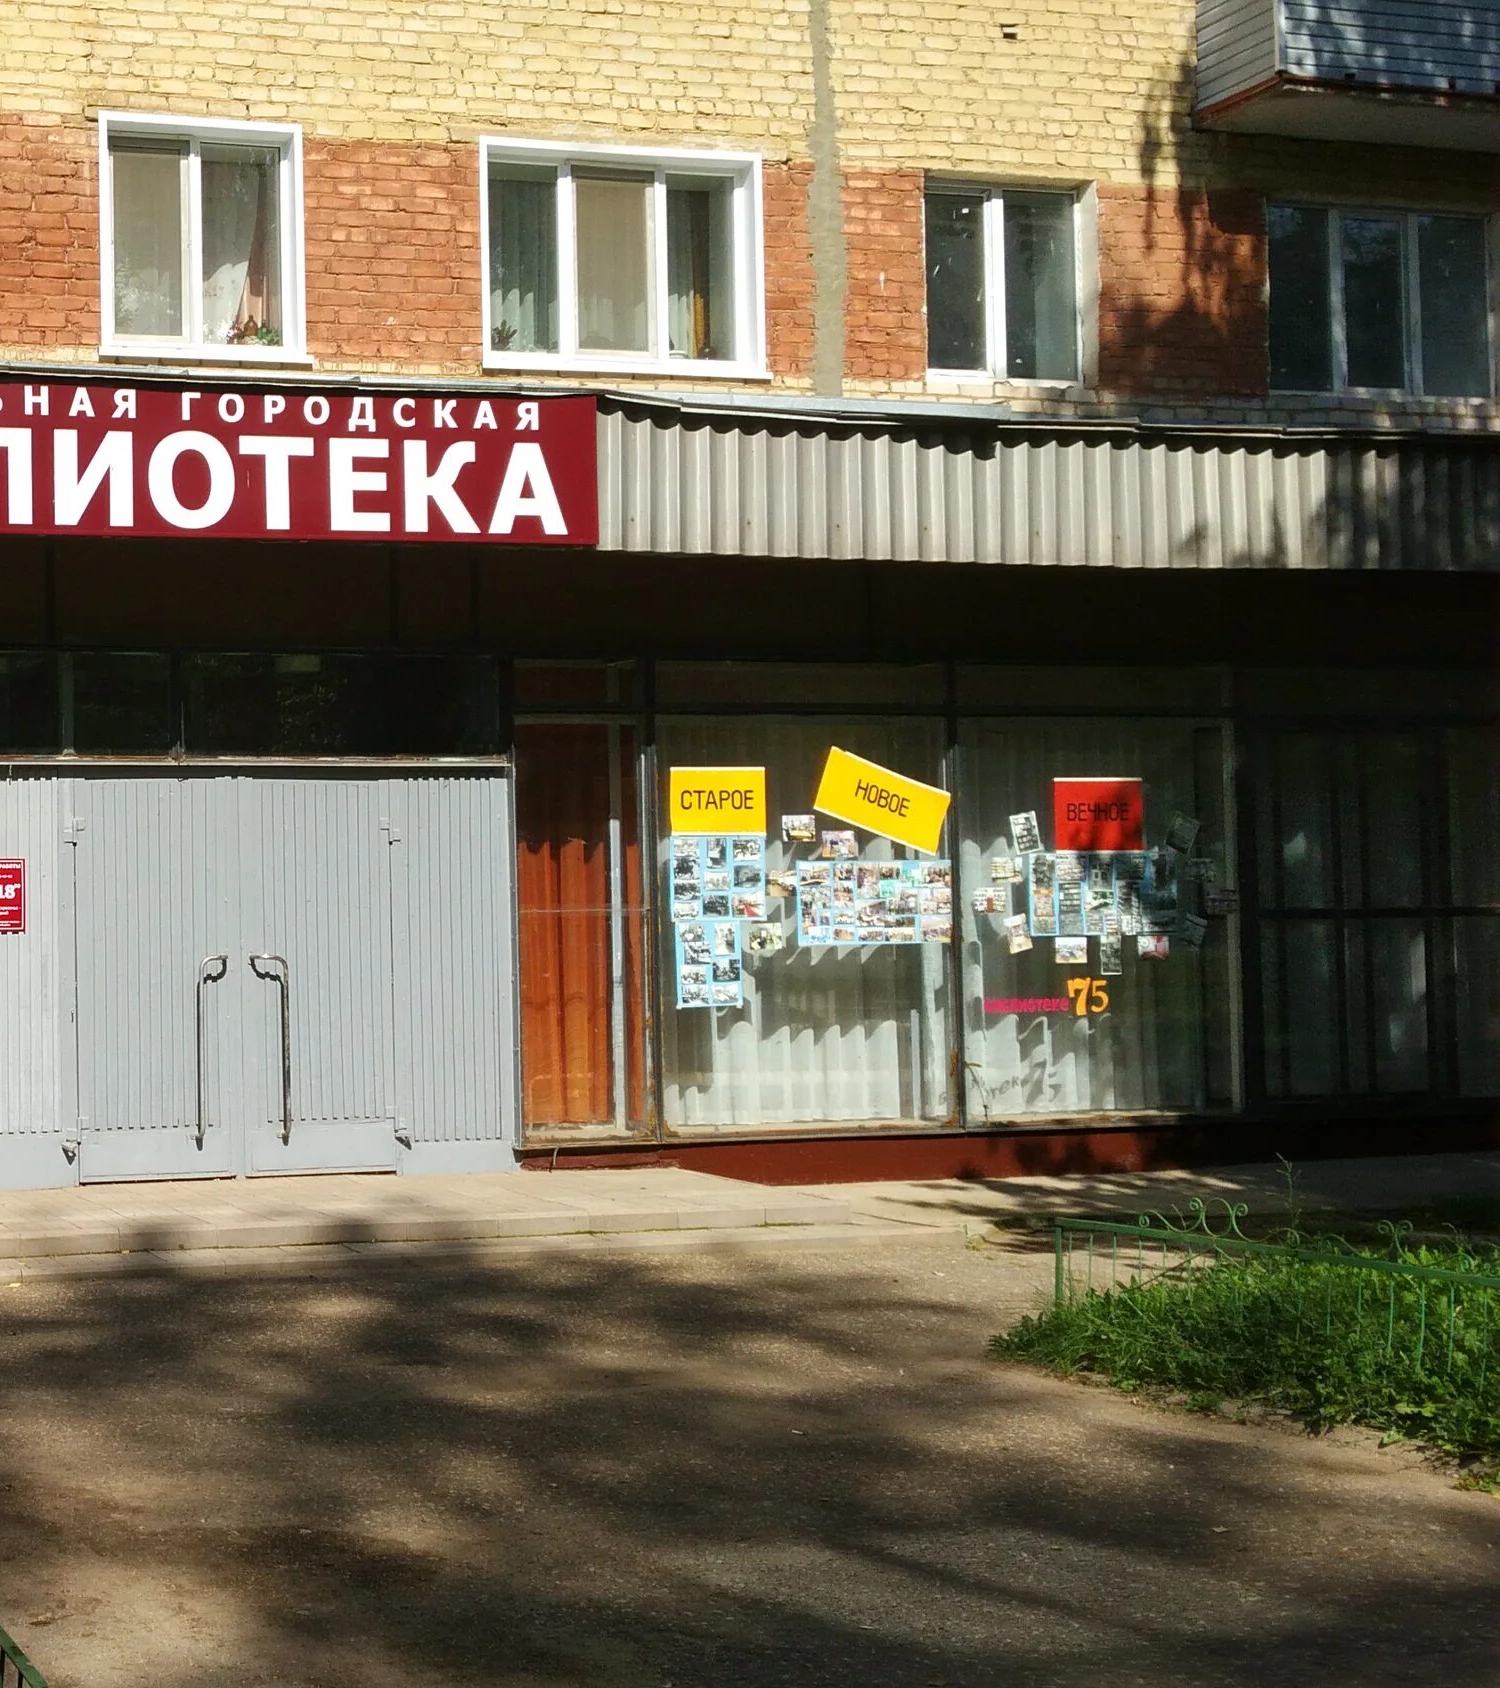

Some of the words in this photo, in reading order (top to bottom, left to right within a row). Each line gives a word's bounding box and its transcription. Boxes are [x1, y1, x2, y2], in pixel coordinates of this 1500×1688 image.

[181, 391, 540, 432] ГОРОДСКАЯ
[680, 789, 755, 811] СТАРОЕ
[854, 778, 911, 818] НОВОЕ
[1066, 802, 1129, 822] ВЕЧНОЕ
[1067, 977, 1109, 1016] 75
